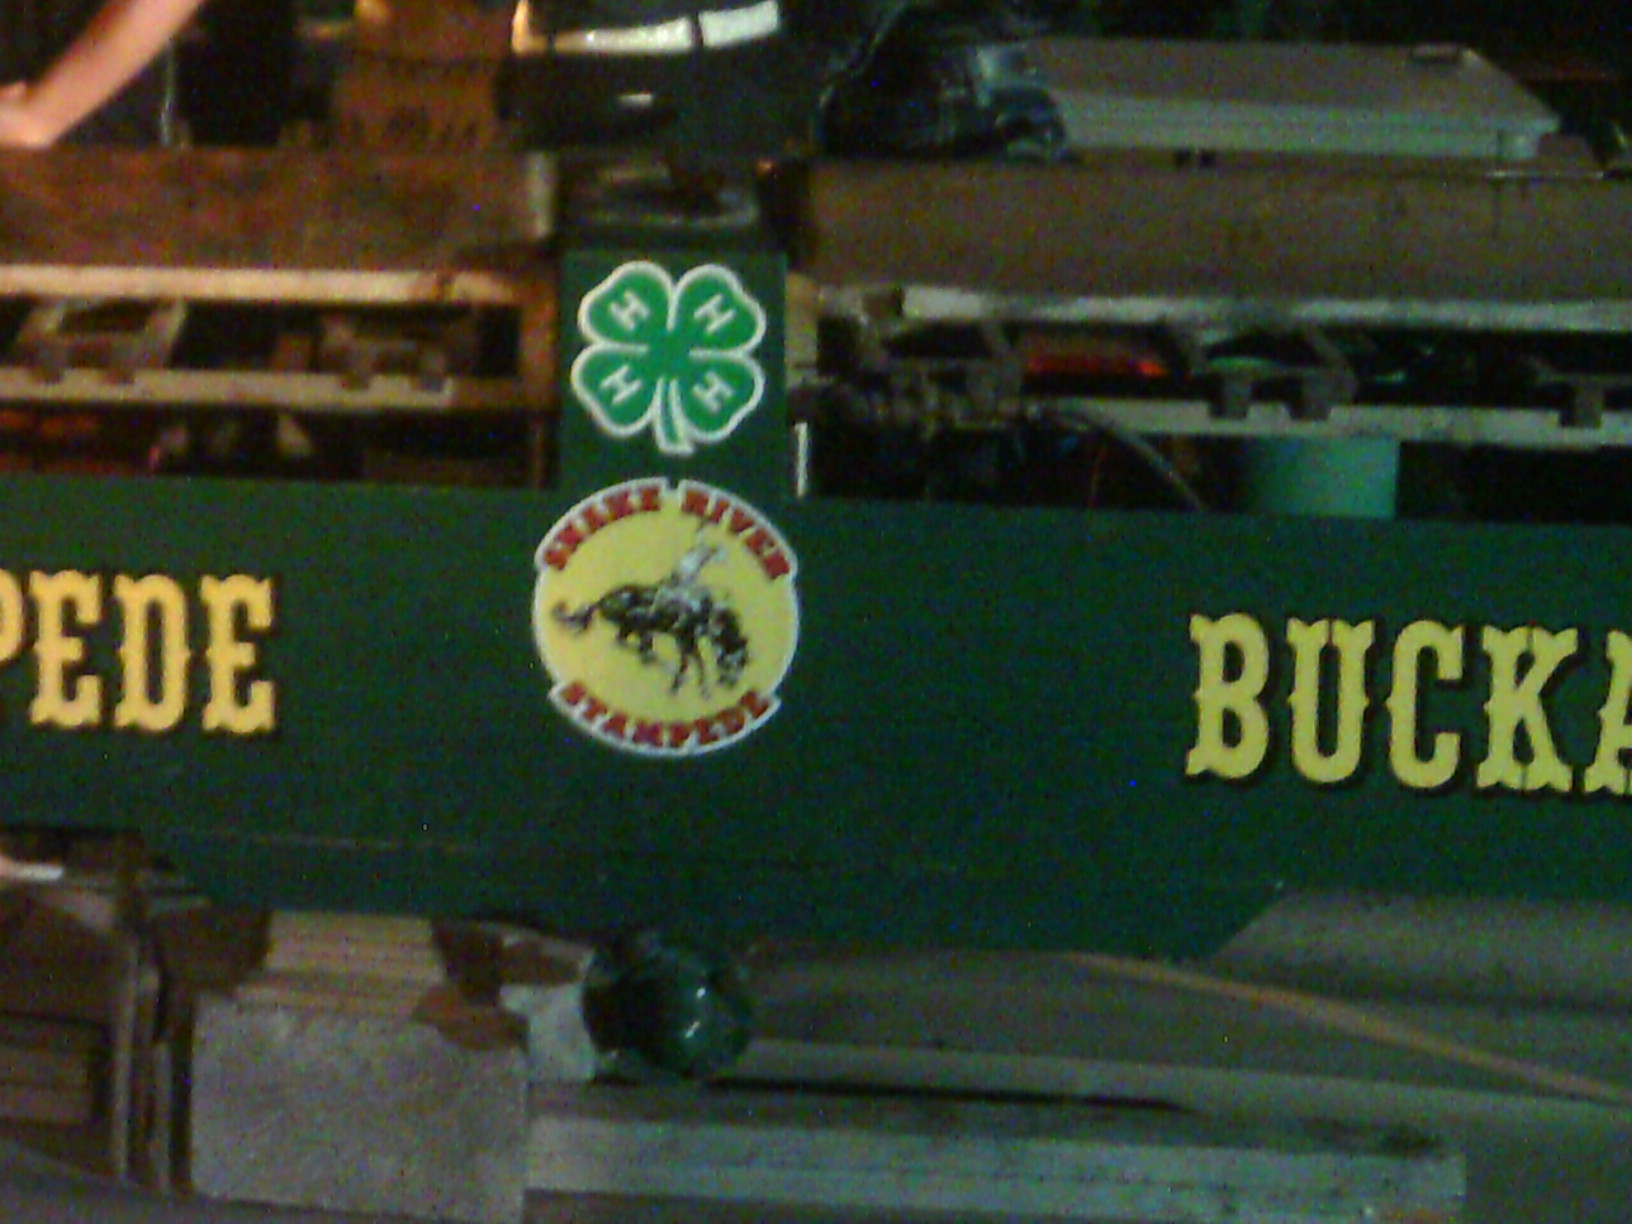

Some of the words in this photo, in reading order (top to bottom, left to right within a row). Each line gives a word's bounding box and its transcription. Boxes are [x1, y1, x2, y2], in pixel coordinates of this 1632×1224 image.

[609, 289, 651, 330] H
[693, 293, 737, 334] H
[600, 364, 643, 405] H
[693, 371, 735, 413] H
